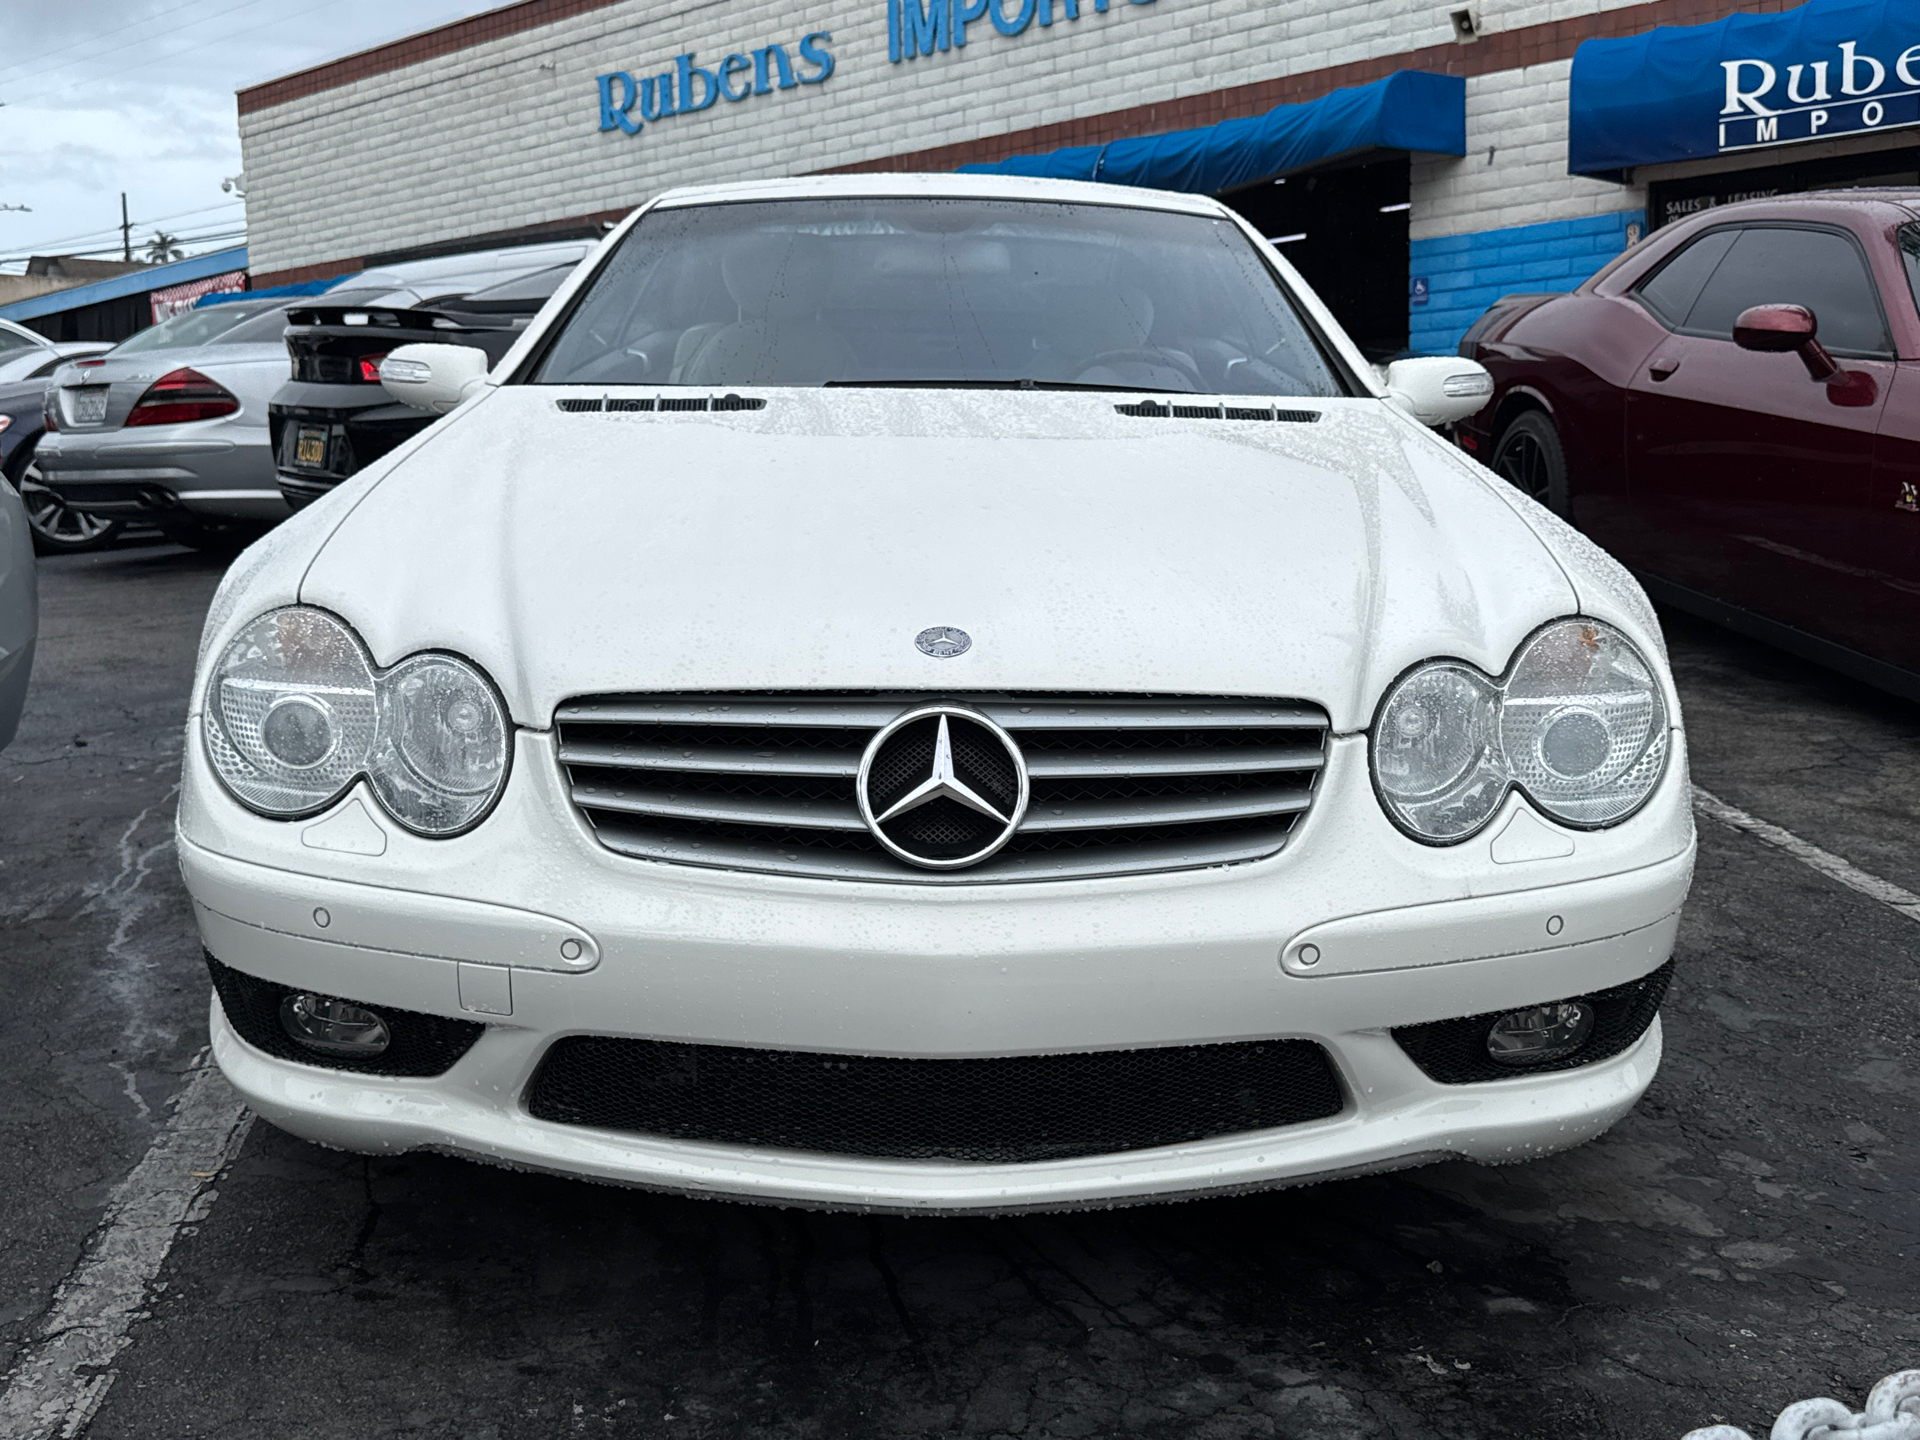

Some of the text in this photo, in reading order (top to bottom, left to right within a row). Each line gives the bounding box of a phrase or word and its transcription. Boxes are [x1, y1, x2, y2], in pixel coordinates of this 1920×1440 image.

[887, 0, 1157, 63] IMPO
[597, 31, 835, 136] Rubens
[1719, 41, 1920, 117] Rube
[1719, 101, 1884, 146] IMPO
[1665, 198, 1701, 215] SALES
